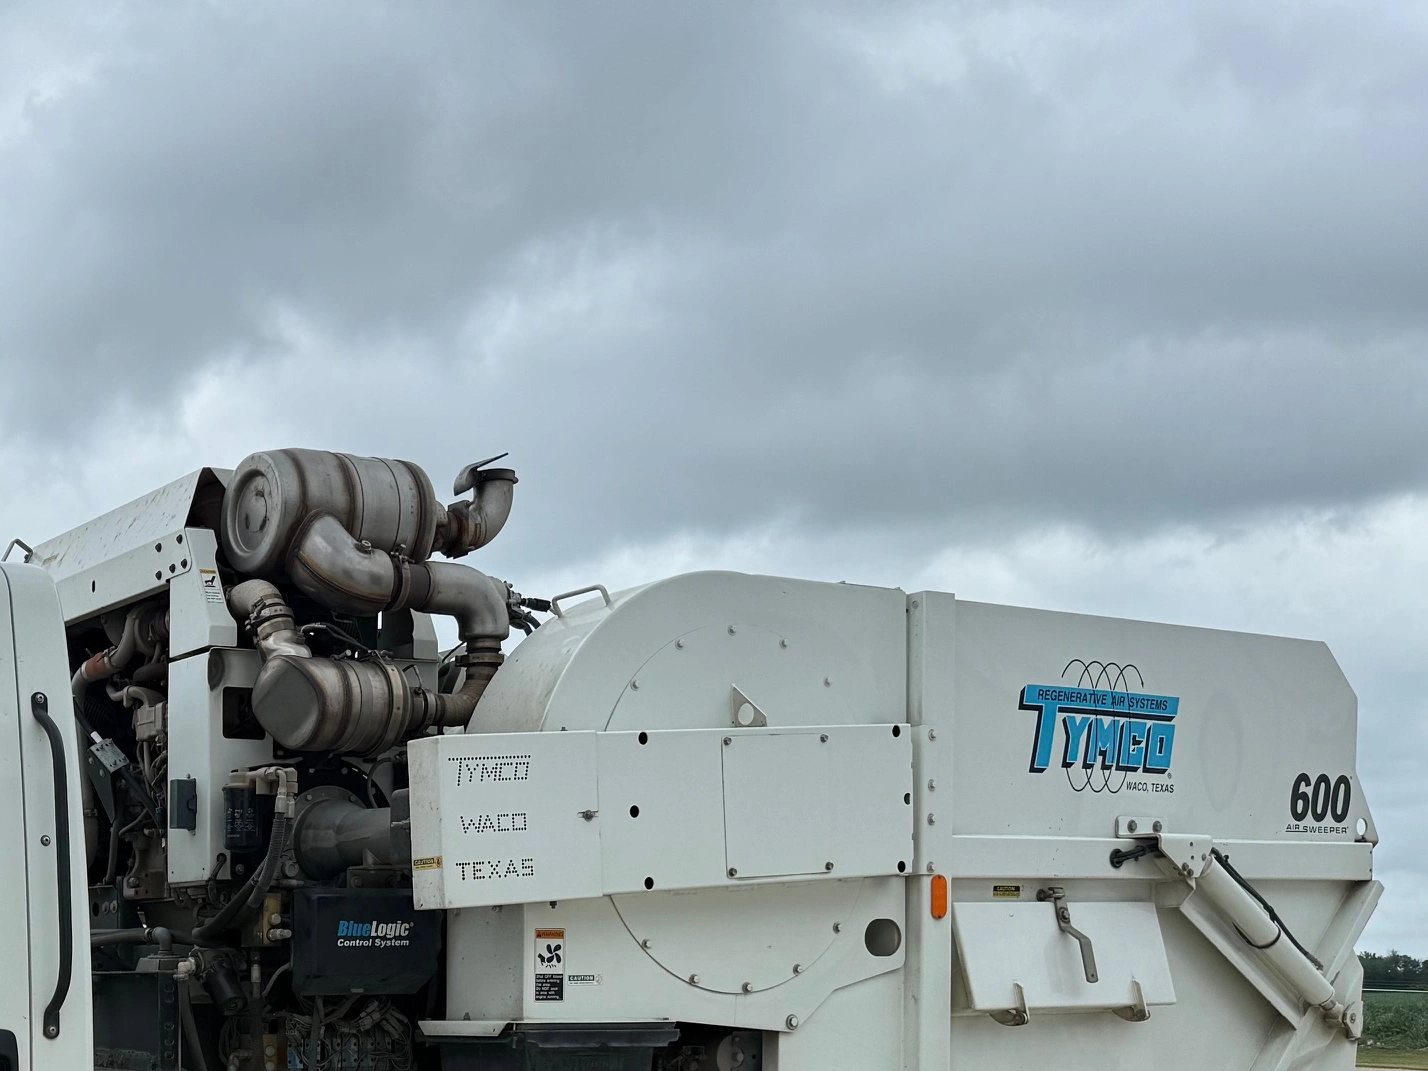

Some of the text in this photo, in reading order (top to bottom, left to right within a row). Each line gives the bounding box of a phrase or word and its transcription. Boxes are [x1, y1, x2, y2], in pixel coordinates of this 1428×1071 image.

[1037, 688, 1169, 711] REGENERATIVE AIR SYSTEMS
[1018, 684, 1180, 774] TYMCO
[447, 754, 531, 787] TYMCO
[1125, 780, 1175, 794] WACO, TEXAS
[1290, 772, 1351, 823] 600
[460, 813, 527, 834] WACO
[1285, 823, 1347, 834] AIR SWEEPER
[455, 858, 533, 881] TEXAS
[337, 920, 410, 939] BlueLogic
[337, 938, 410, 949] Control System
